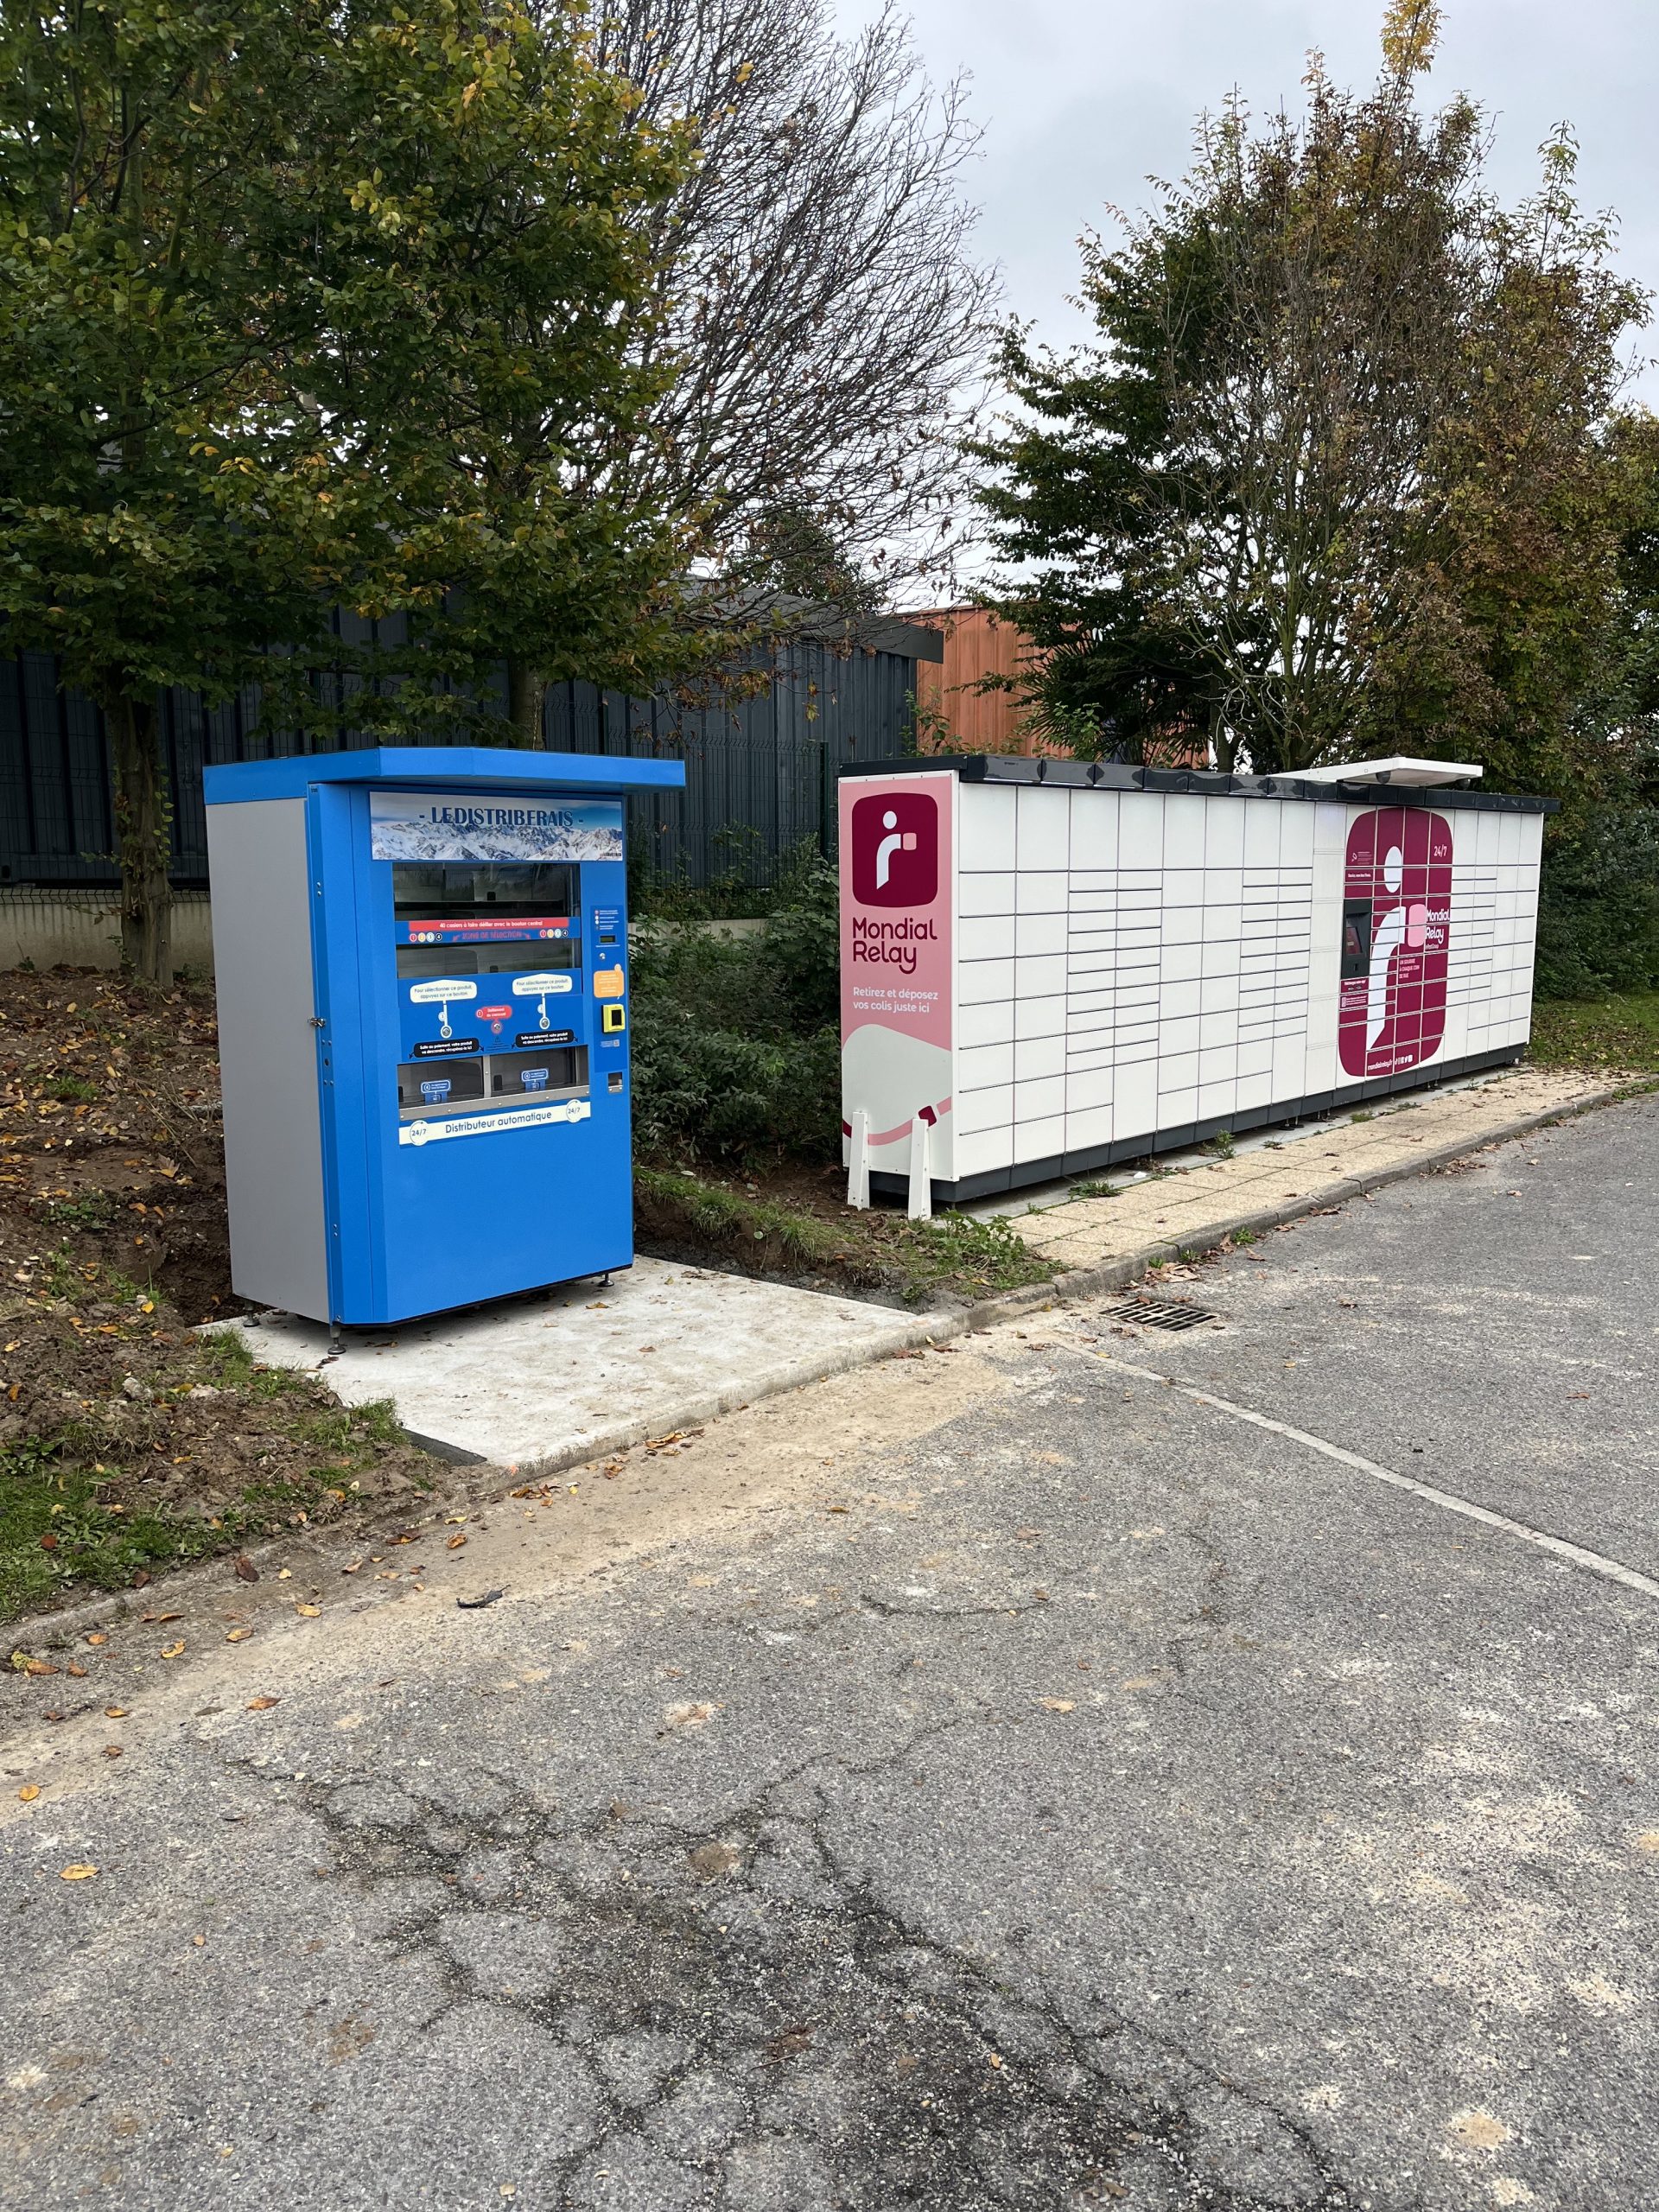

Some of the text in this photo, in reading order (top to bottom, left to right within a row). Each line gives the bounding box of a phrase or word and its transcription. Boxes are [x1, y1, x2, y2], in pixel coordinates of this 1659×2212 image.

[1433, 845, 1447, 857] 24/7
[1426, 908, 1451, 922] Mondial
[852, 917, 938, 940] Mondial
[1425, 926, 1445, 944] Relay
[853, 940, 917, 975] Relay
[853, 987, 938, 1001] Retirez et déposez
[853, 1000, 930, 1014] vos colis juste ici
[445, 1120, 495, 1134] Distributeur
[497, 1112, 552, 1126] automatique
